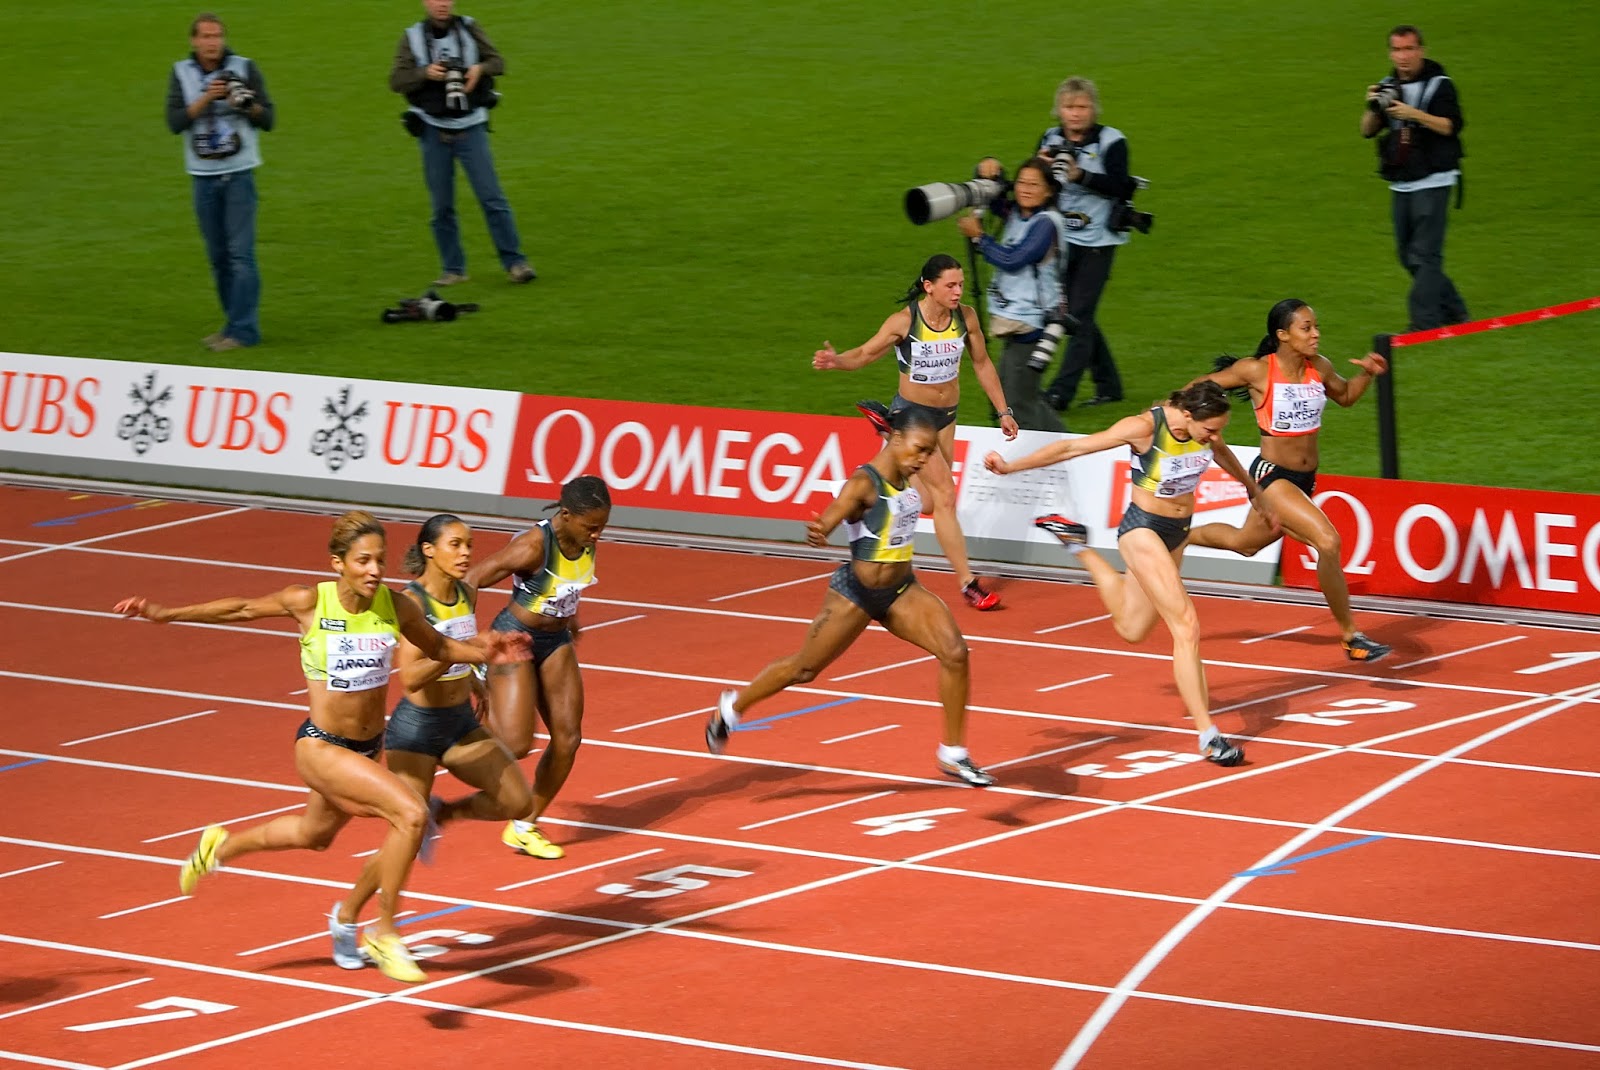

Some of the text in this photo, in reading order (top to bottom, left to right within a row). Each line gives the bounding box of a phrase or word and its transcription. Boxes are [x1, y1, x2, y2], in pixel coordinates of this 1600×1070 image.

[935, 342, 958, 354] UBS
[0, 370, 100, 438] UBS
[185, 385, 292, 454] UBS
[382, 402, 493, 472] UBS
[601, 420, 851, 504] OMEGA
[1394, 503, 1600, 593] OME
[357, 638, 389, 651] UBS
[335, 657, 387, 671] ARRON
[1274, 698, 1416, 726] 2
[1065, 750, 1206, 780] 3
[851, 807, 968, 836] 4
[595, 863, 755, 898] 5
[63, 996, 239, 1032] 7
